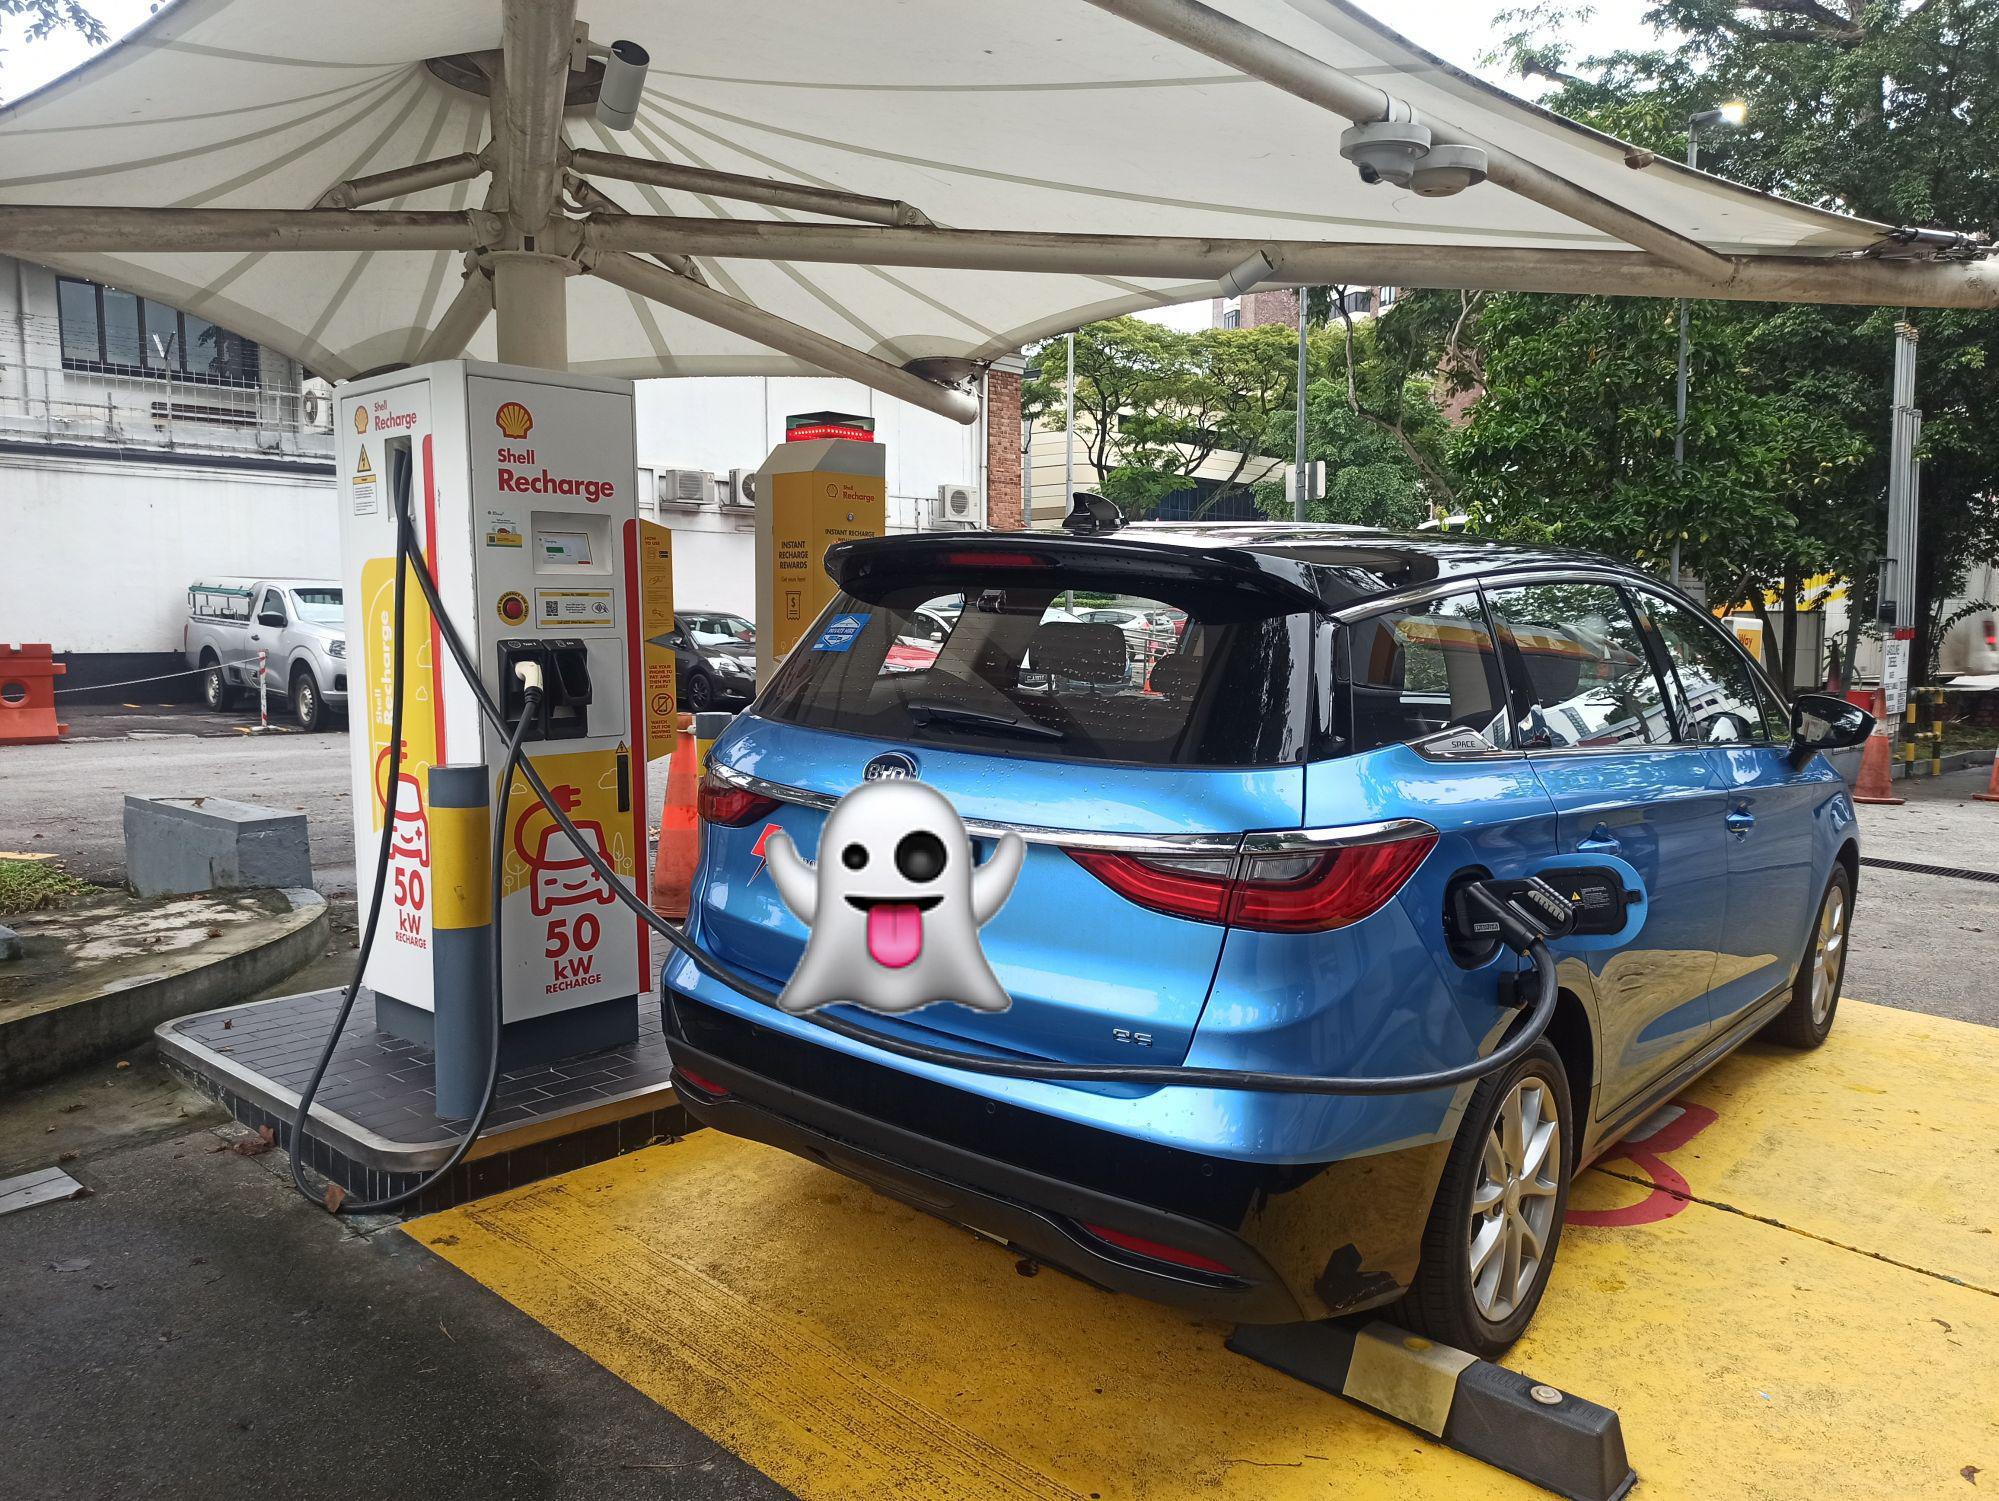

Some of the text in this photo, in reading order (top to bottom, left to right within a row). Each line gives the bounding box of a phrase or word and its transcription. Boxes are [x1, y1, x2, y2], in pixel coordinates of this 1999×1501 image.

[374, 400, 388, 412] Shell
[374, 411, 417, 431] Recharge
[497, 448, 535, 464] Shell
[497, 468, 615, 503] Recharge
[843, 491, 875, 502] Recharge
[825, 528, 847, 536] INSTANT
[781, 541, 805, 549] INSTANT
[778, 551, 808, 559] RECHARGE
[780, 561, 807, 569] REWARDS
[1738, 633, 1753, 649] Way
[381, 610, 393, 726] Recharge
[375, 688, 383, 725] Shell
[1451, 740, 1476, 749] SPACE
[867, 763, 906, 781] BYD
[394, 866, 425, 911] 50
[399, 909, 422, 935] kW
[395, 931, 427, 949] RECHARGE
[545, 912, 600, 958] 50
[553, 955, 593, 981] kW
[545, 974, 602, 994] RECHARGE
